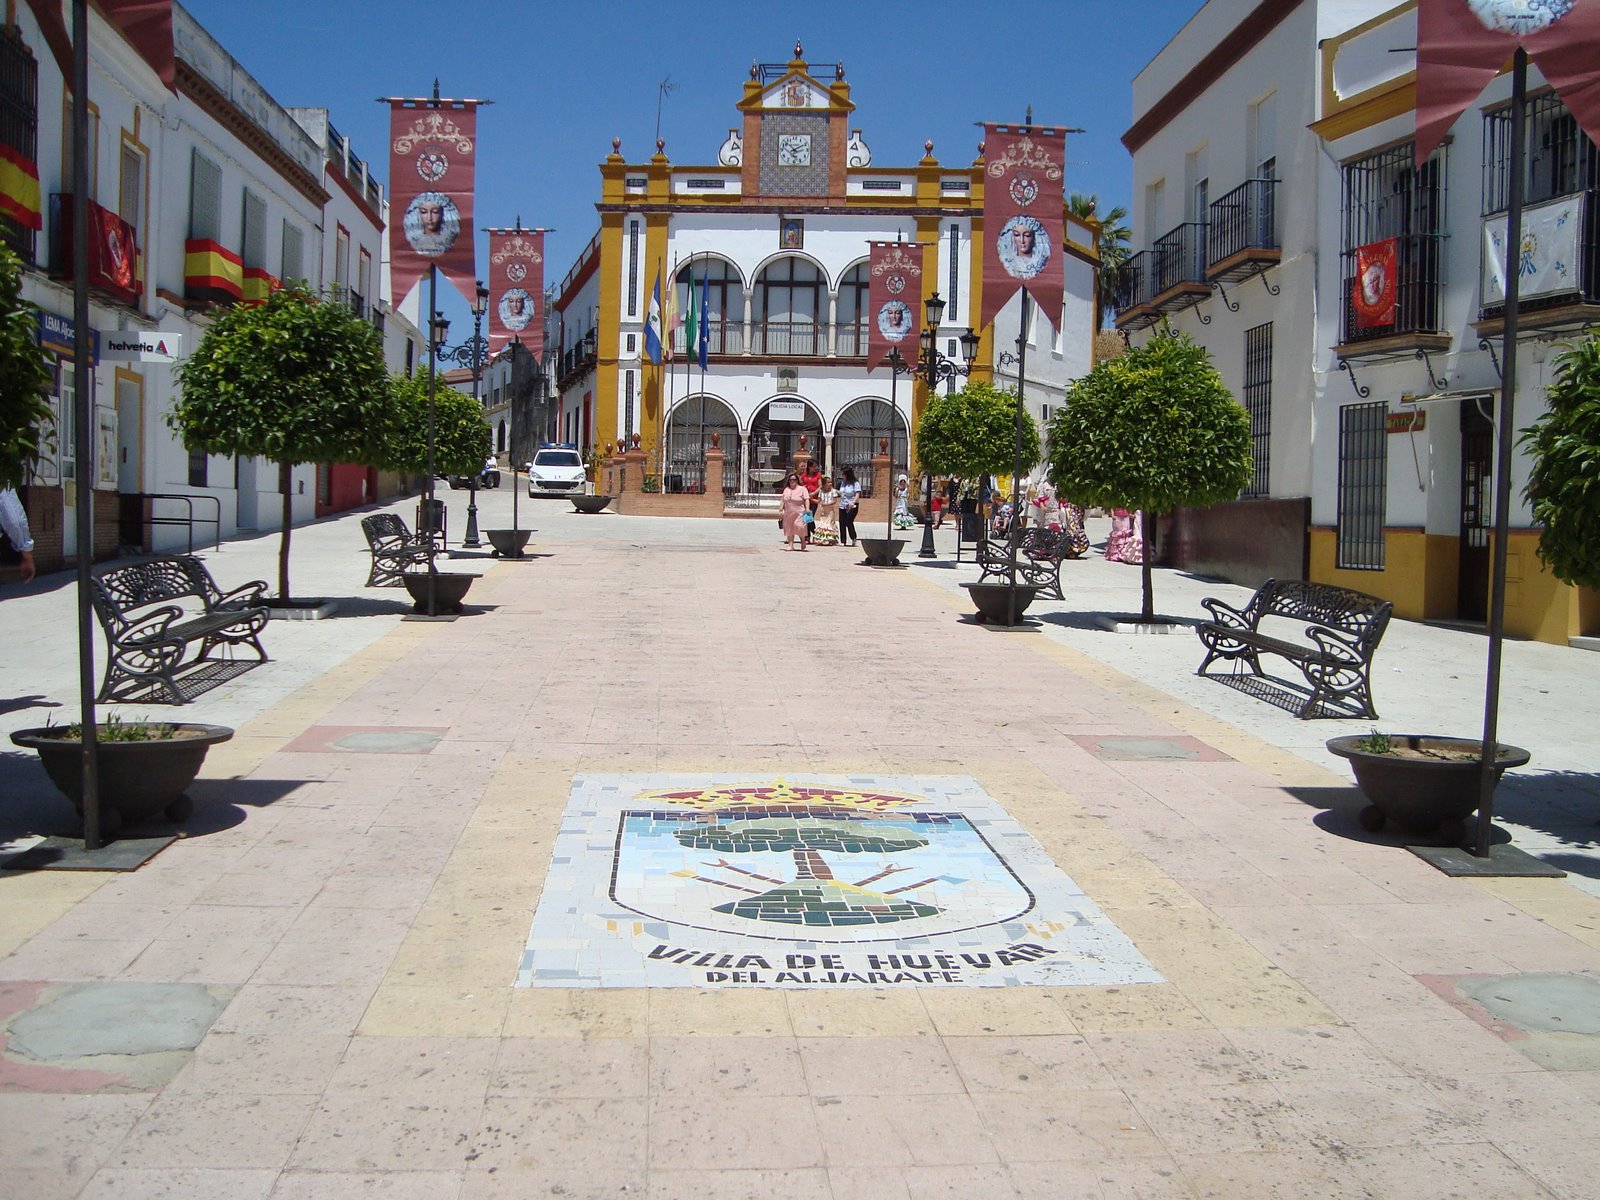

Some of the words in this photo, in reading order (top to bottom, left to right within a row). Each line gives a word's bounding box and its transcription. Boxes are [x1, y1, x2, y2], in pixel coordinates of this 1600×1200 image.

[108, 340, 154, 353] helvetia
[785, 953, 845, 970] DE
[706, 971, 766, 984] DEL
[774, 971, 965, 984] ALJARAFE
